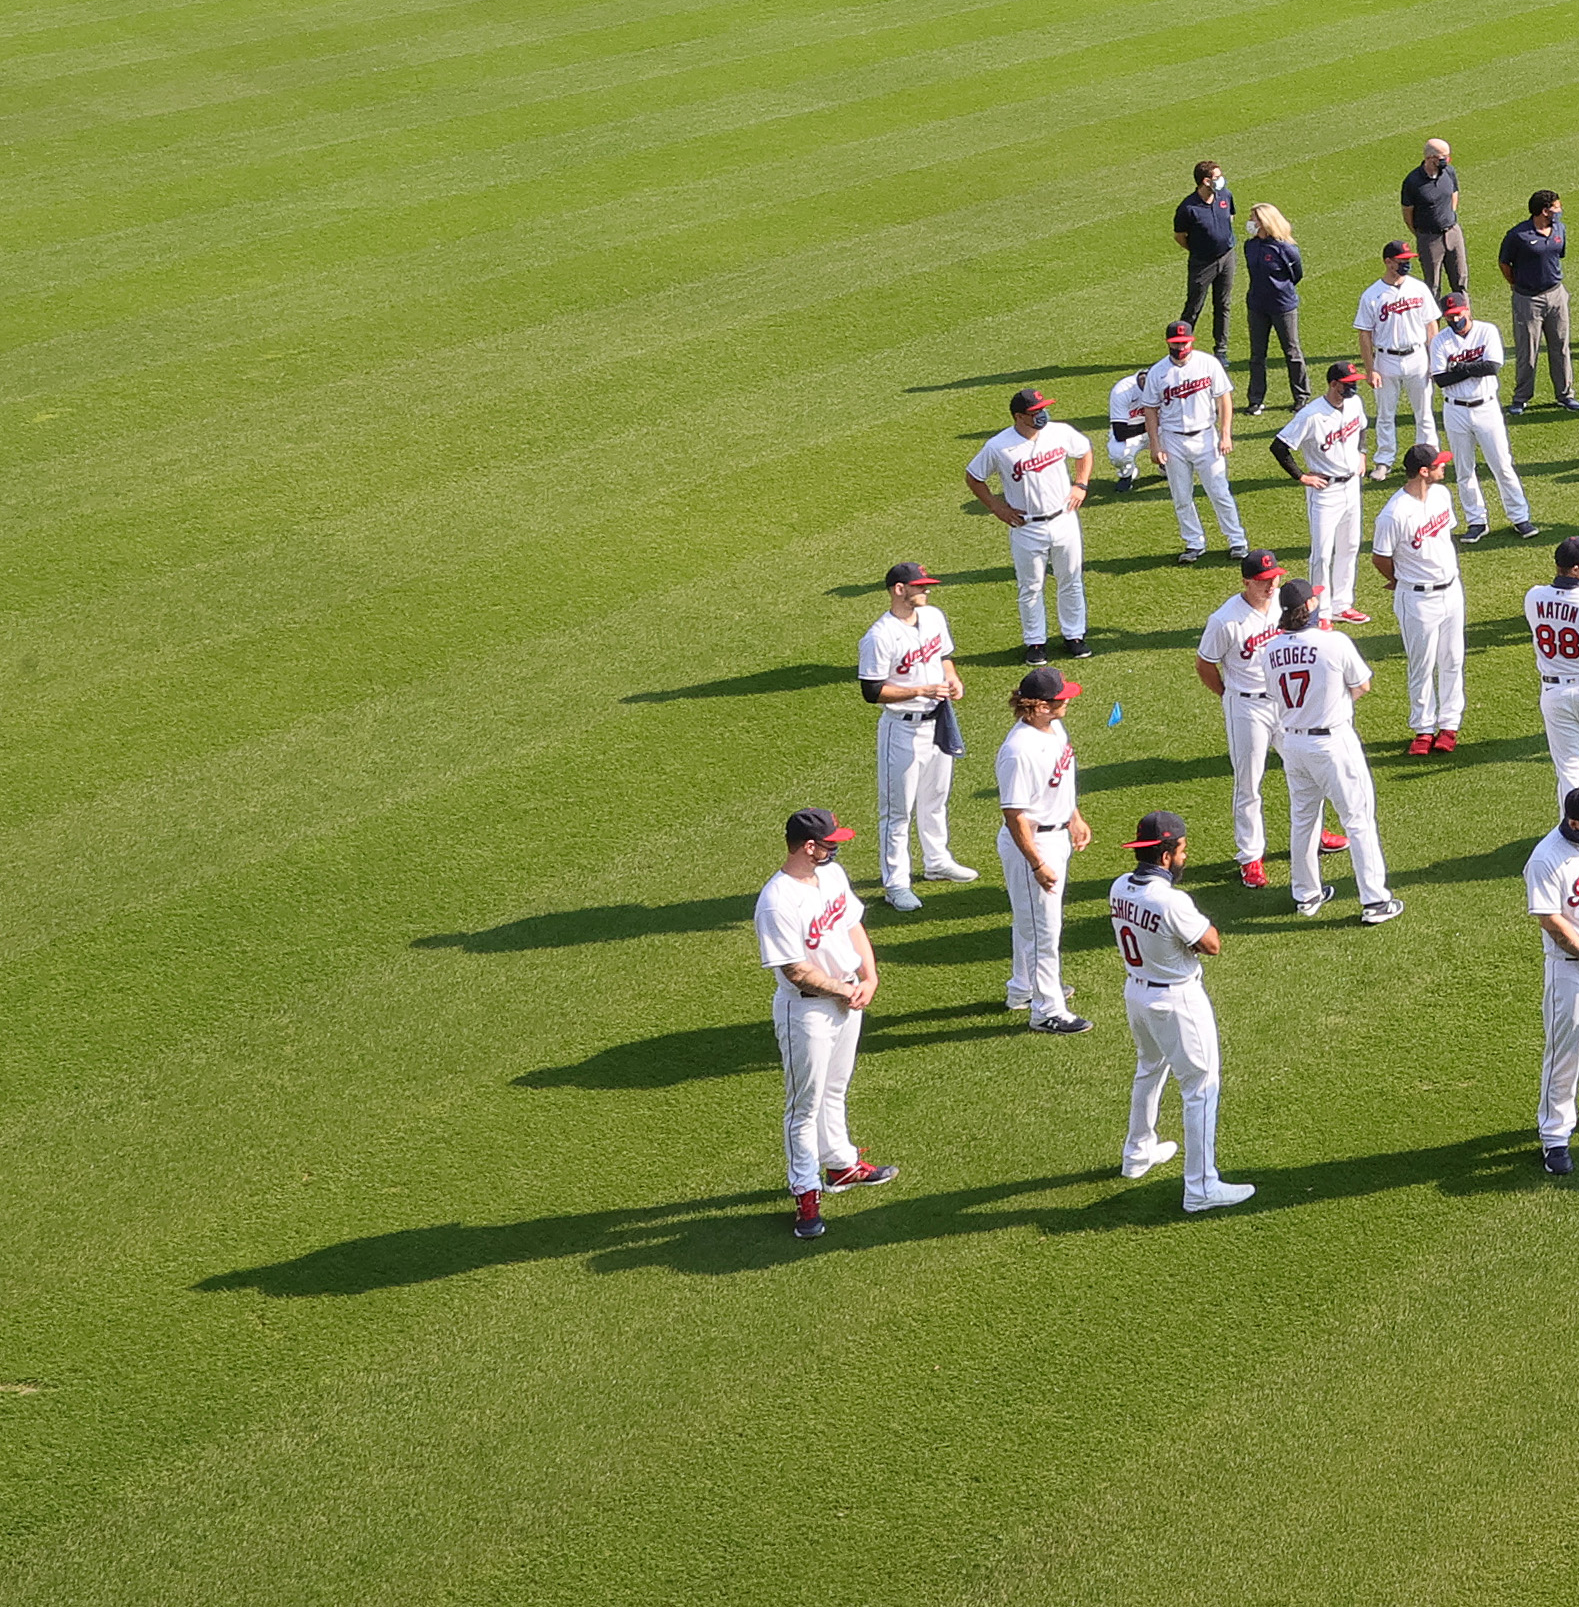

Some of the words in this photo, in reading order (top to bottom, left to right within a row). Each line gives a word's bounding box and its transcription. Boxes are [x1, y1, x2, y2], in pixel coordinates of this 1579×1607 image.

[1379, 296, 1425, 322] Indians
[1162, 376, 1213, 406] Indians
[1320, 415, 1361, 452] Indians
[1012, 446, 1068, 482] Indians
[1535, 600, 1579, 624] MATON
[1269, 646, 1318, 670] HEDGES
[1278, 670, 1311, 709] 17
[1119, 925, 1144, 968] 0
